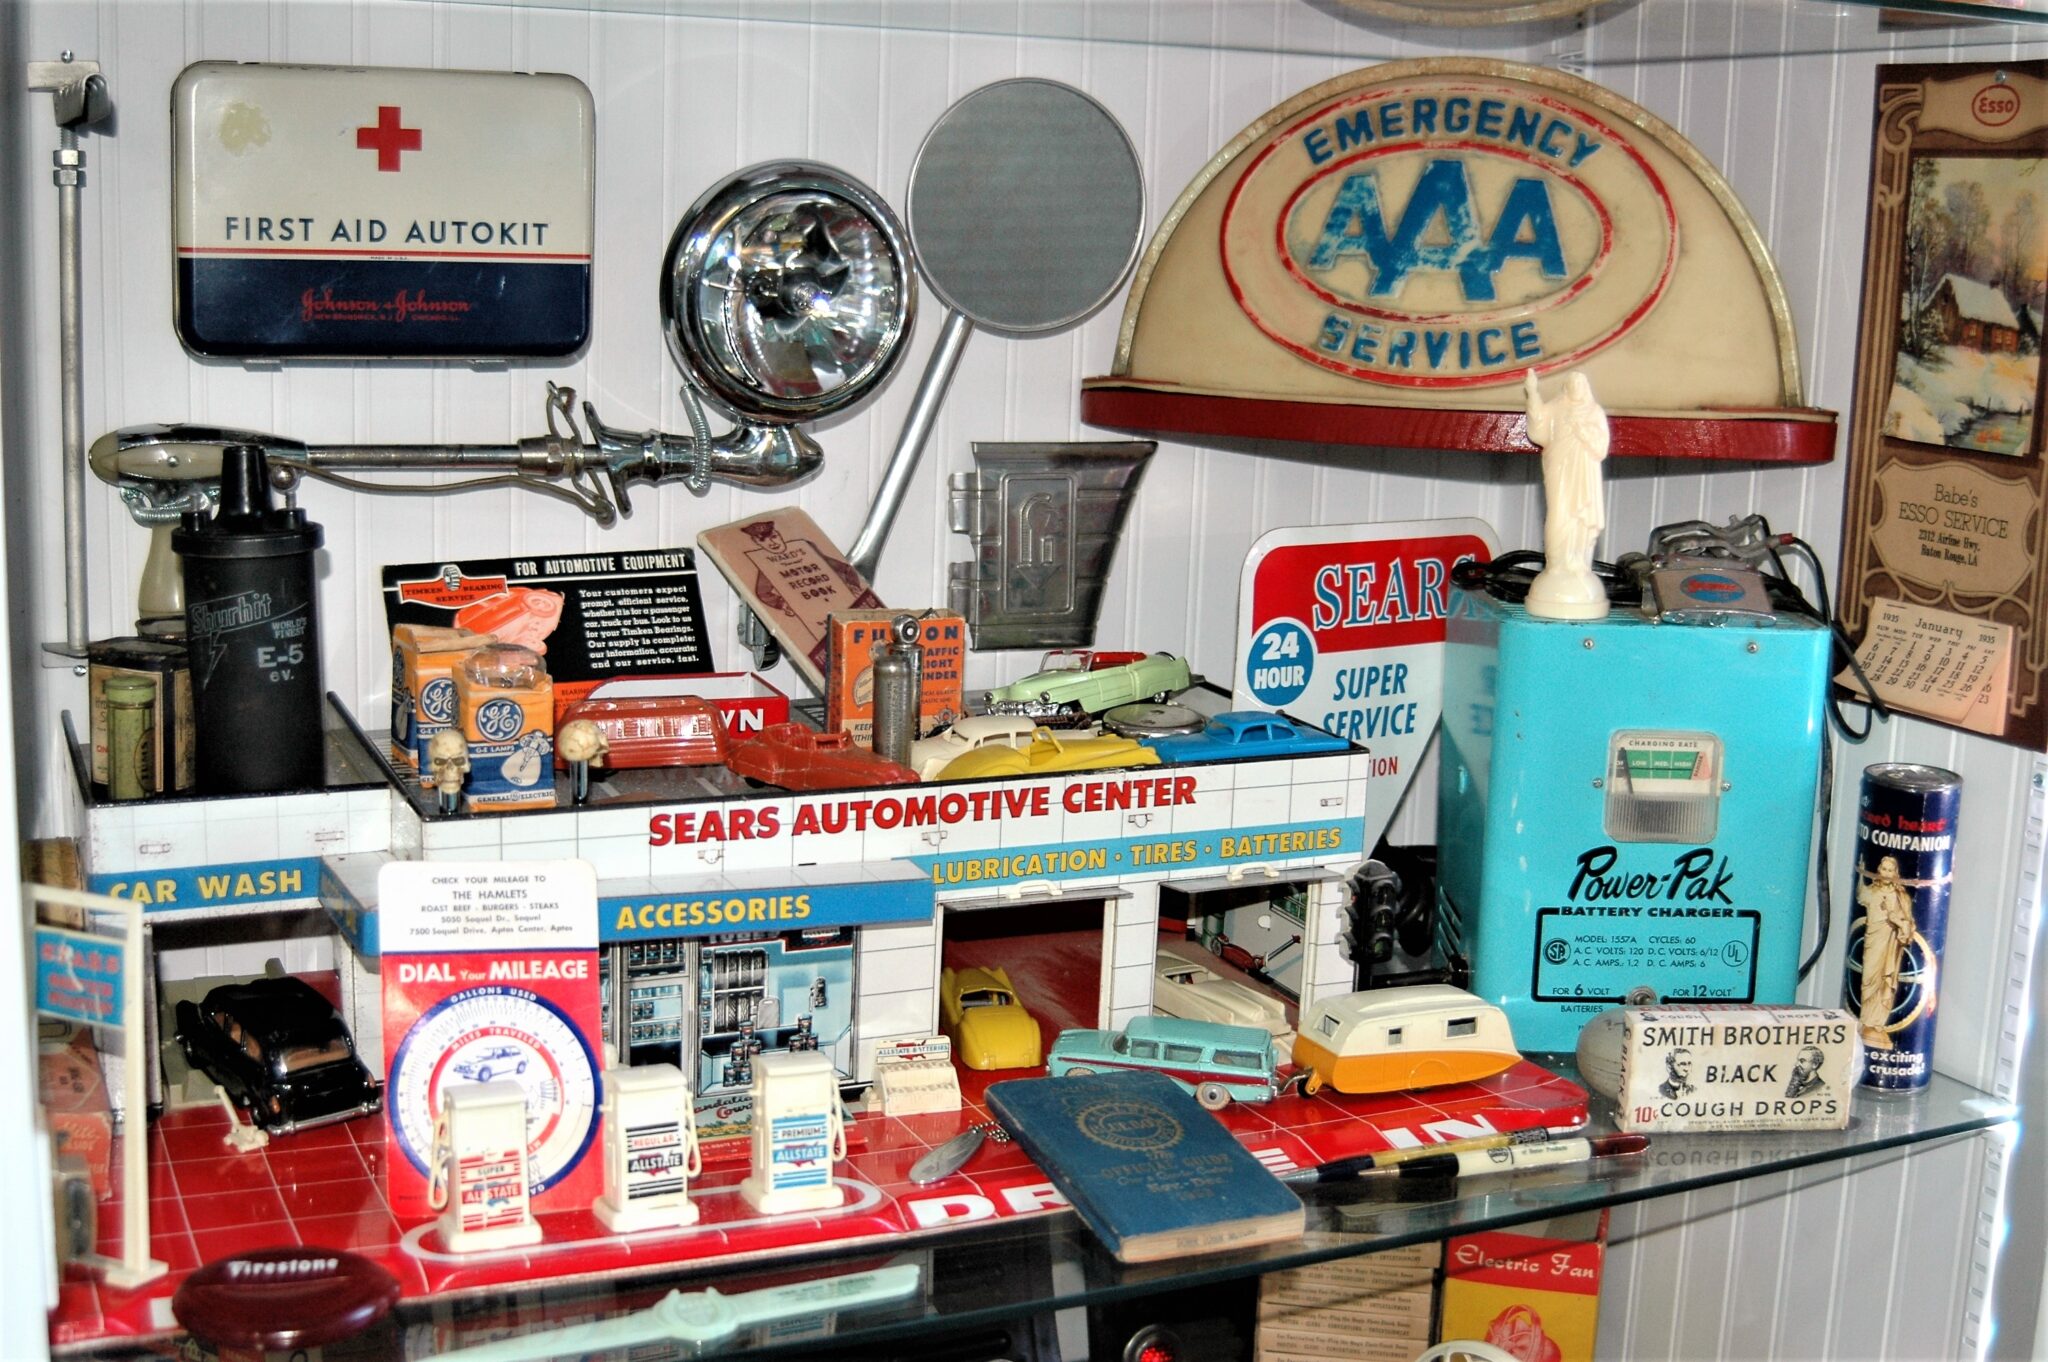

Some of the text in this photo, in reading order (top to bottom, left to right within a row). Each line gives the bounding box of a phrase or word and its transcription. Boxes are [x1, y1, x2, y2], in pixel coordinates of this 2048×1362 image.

[1302, 97, 1601, 168] EMERGENCY
[225, 216, 548, 246] FIRST AID AUTOKIT
[1308, 157, 1567, 301] AAA
[301, 288, 471, 322] Johnson Johnson
[1320, 316, 1542, 371] SERVICE
[1934, 483, 1978, 508] Babe's
[1898, 502, 2008, 539] ESSO SERVICE
[1918, 529, 1935, 542] 2312
[1964, 537, 1980, 552] Hwy.
[766, 549, 806, 562] WARD'S
[1921, 544, 1977, 566] Baton Rouge, LA
[515, 553, 686, 576] FOR AUTOMOTIVE EQUIPMENT
[779, 563, 821, 578] MOTOR
[656, 586, 686, 594] expect
[789, 574, 830, 589] RECORD
[406, 588, 442, 596] TIMKEN
[801, 585, 837, 600] BOOK
[618, 598, 652, 606] efficient
[583, 609, 615, 617] whether
[650, 606, 690, 615] passenger
[601, 619, 622, 627] truck
[651, 616, 671, 624] Look
[1883, 612, 1899, 623] 1935
[1915, 618, 1964, 638] January
[1978, 634, 1996, 644] 1935
[274, 626, 305, 639] FINEST
[600, 630, 620, 638] your
[621, 628, 653, 636] Timken
[654, 626, 694, 634] Bearings.
[587, 639, 639, 648] Our supply
[1261, 631, 1300, 661] 24
[258, 644, 304, 668] E-5
[1253, 664, 1305, 689] HOUR
[1332, 663, 1409, 701] SUPER
[1323, 703, 1418, 740] SERVICE
[477, 791, 555, 803] GENERAL ELECTRIC
[648, 775, 1197, 847] SEARS AUTOMOTIVE CENTER
[1898, 815, 1949, 832] heart
[1871, 830, 1951, 851] COMPANION
[932, 826, 1342, 886] LUBRICATION TIRES BATTERIES
[1567, 845, 1734, 904] Power-Pak
[108, 869, 303, 911] CAR WASH
[453, 890, 528, 900] THE HAMLETS
[615, 894, 812, 931] ACCESSORIES
[1560, 907, 1736, 918] BATTERY CHARGER
[409, 927, 430, 935] 7500
[491, 926, 514, 934] Aptos
[550, 925, 573, 933] Aptos
[1574, 935, 1607, 943] MODEL:
[1649, 936, 1682, 944] CYCLES:
[1669, 948, 1698, 956] VOLTS:
[1700, 949, 1718, 957] 6/12
[1727, 944, 1742, 962] UL
[400, 960, 588, 983] DIAL Your MILEAGE
[451, 986, 537, 1003] GALLONS USED
[1552, 984, 1610, 995] FOR 6 VOLT
[1672, 985, 1732, 997] FOR 12 VOLT
[1560, 1005, 1603, 1013] BATTERIES
[452, 1027, 541, 1050] MILES TRAVELED
[1642, 1024, 1847, 1047] SMITH BROTHERS
[1870, 1051, 1924, 1062] exciting
[1705, 1064, 1777, 1083] BLACK
[1870, 1063, 1925, 1076] crusade!
[1660, 1100, 1837, 1118] COUGH DROPS
[781, 1127, 821, 1138] PREMIUM
[1381, 1113, 1500, 1149] IN
[633, 1134, 675, 1148] REGULAR
[776, 1145, 825, 1161] ALLSTATE
[478, 1166, 505, 1175] SUPER
[630, 1154, 681, 1171] ALLSTATE
[227, 1258, 339, 1277] Firestone
[1455, 1244, 1595, 1279] Electric Fan
